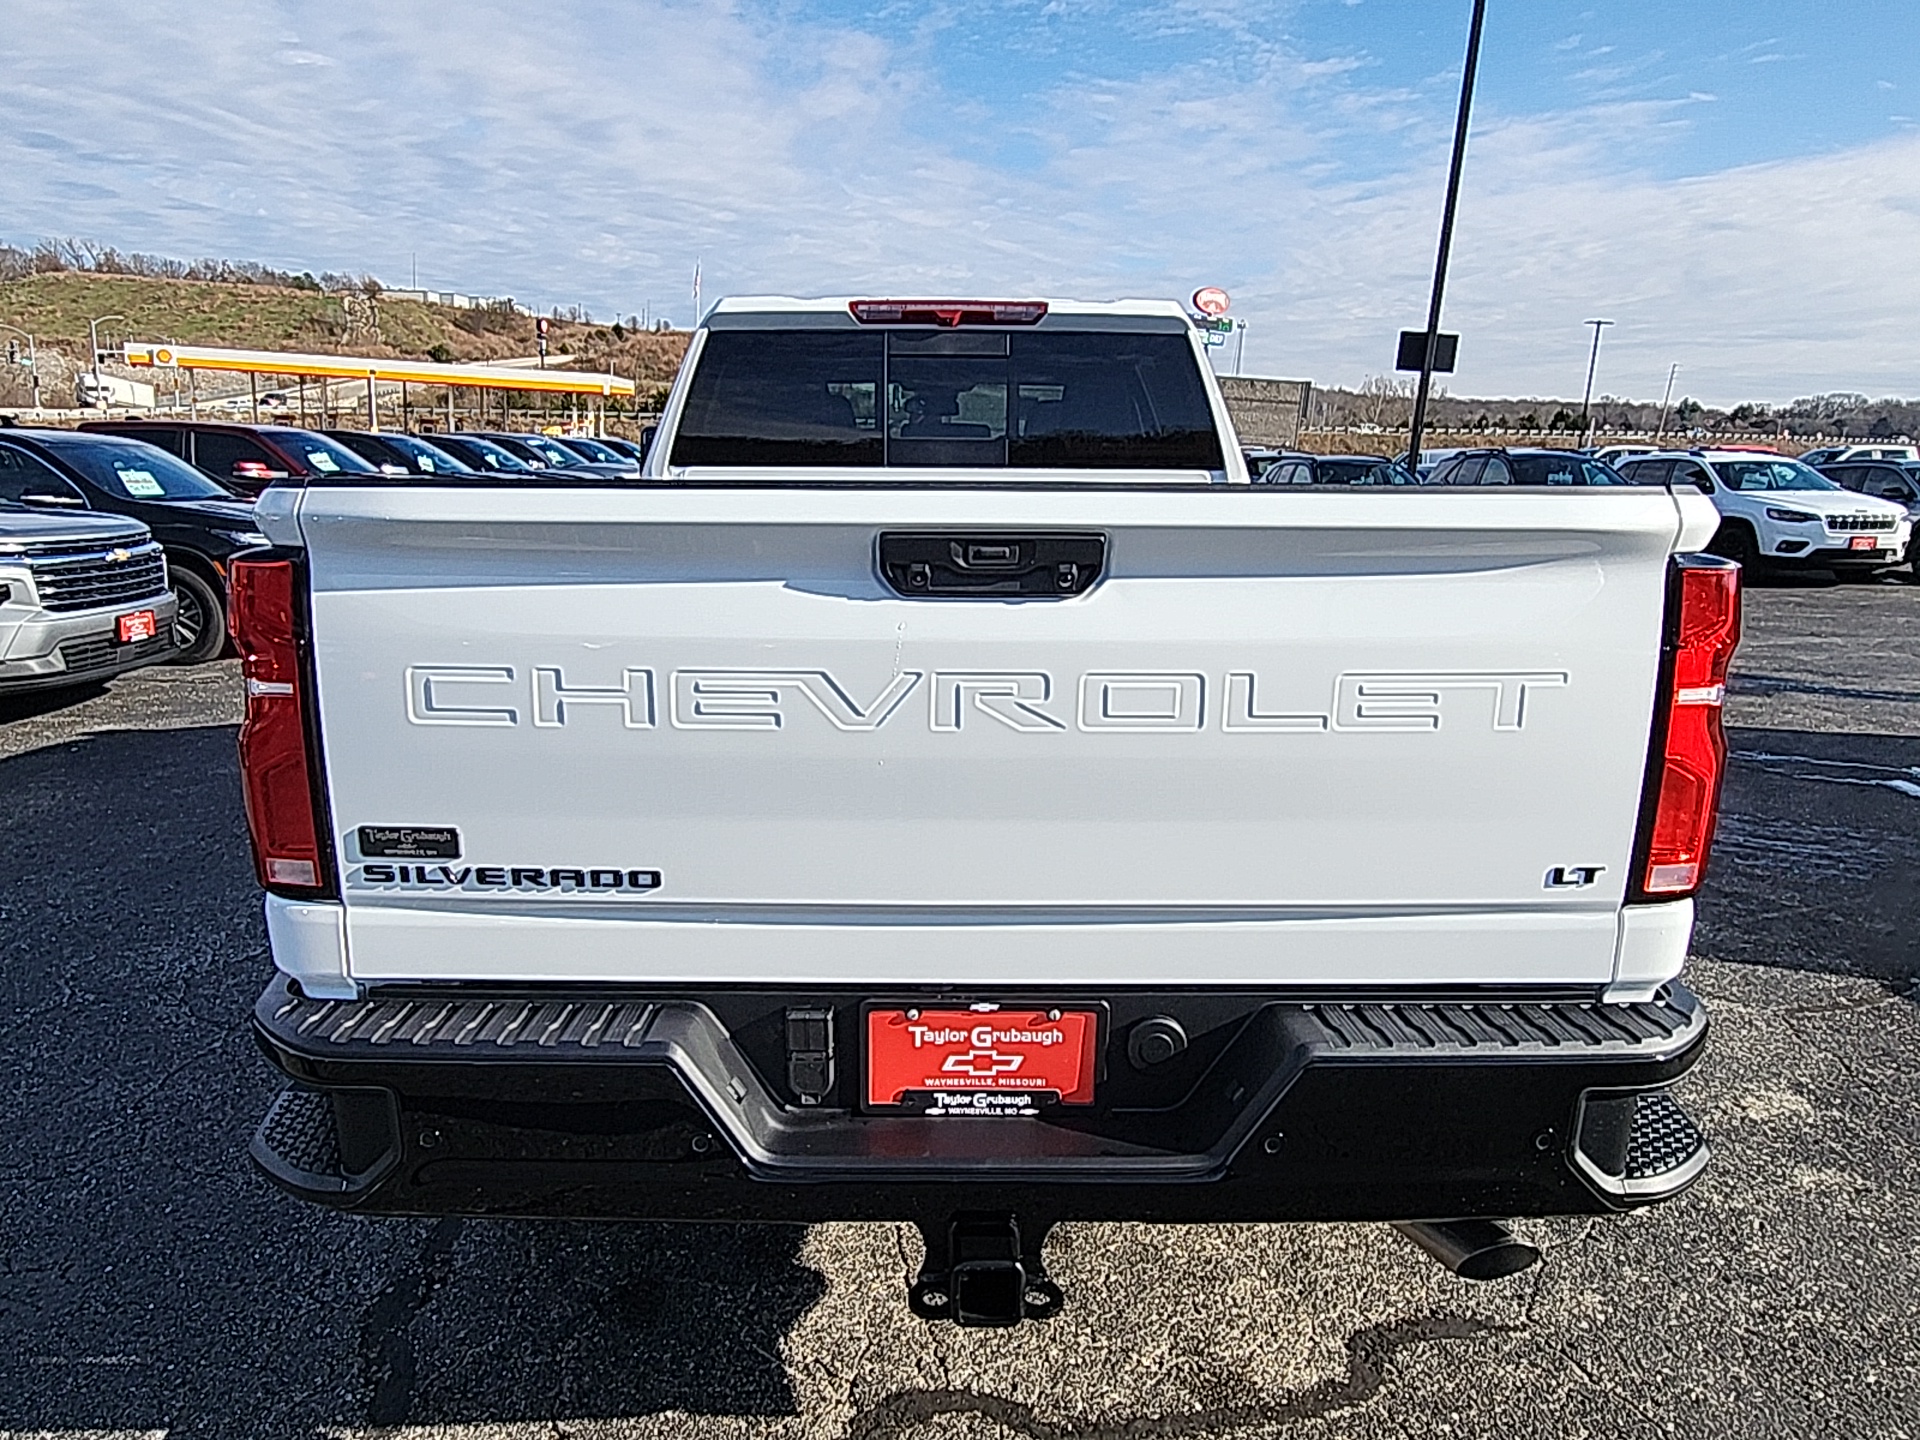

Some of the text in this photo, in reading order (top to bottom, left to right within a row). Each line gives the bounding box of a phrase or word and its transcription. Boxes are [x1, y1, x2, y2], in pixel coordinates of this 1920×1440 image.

[405, 663, 1570, 733] CHEVROLET
[363, 864, 662, 890] SILVERADO
[1550, 866, 1606, 885] LT
[908, 1026, 1063, 1048] Taylor Grubaugh
[998, 1078, 1046, 1087] MISSOURI
[933, 1092, 1032, 1108] Taylor Grubaugh
